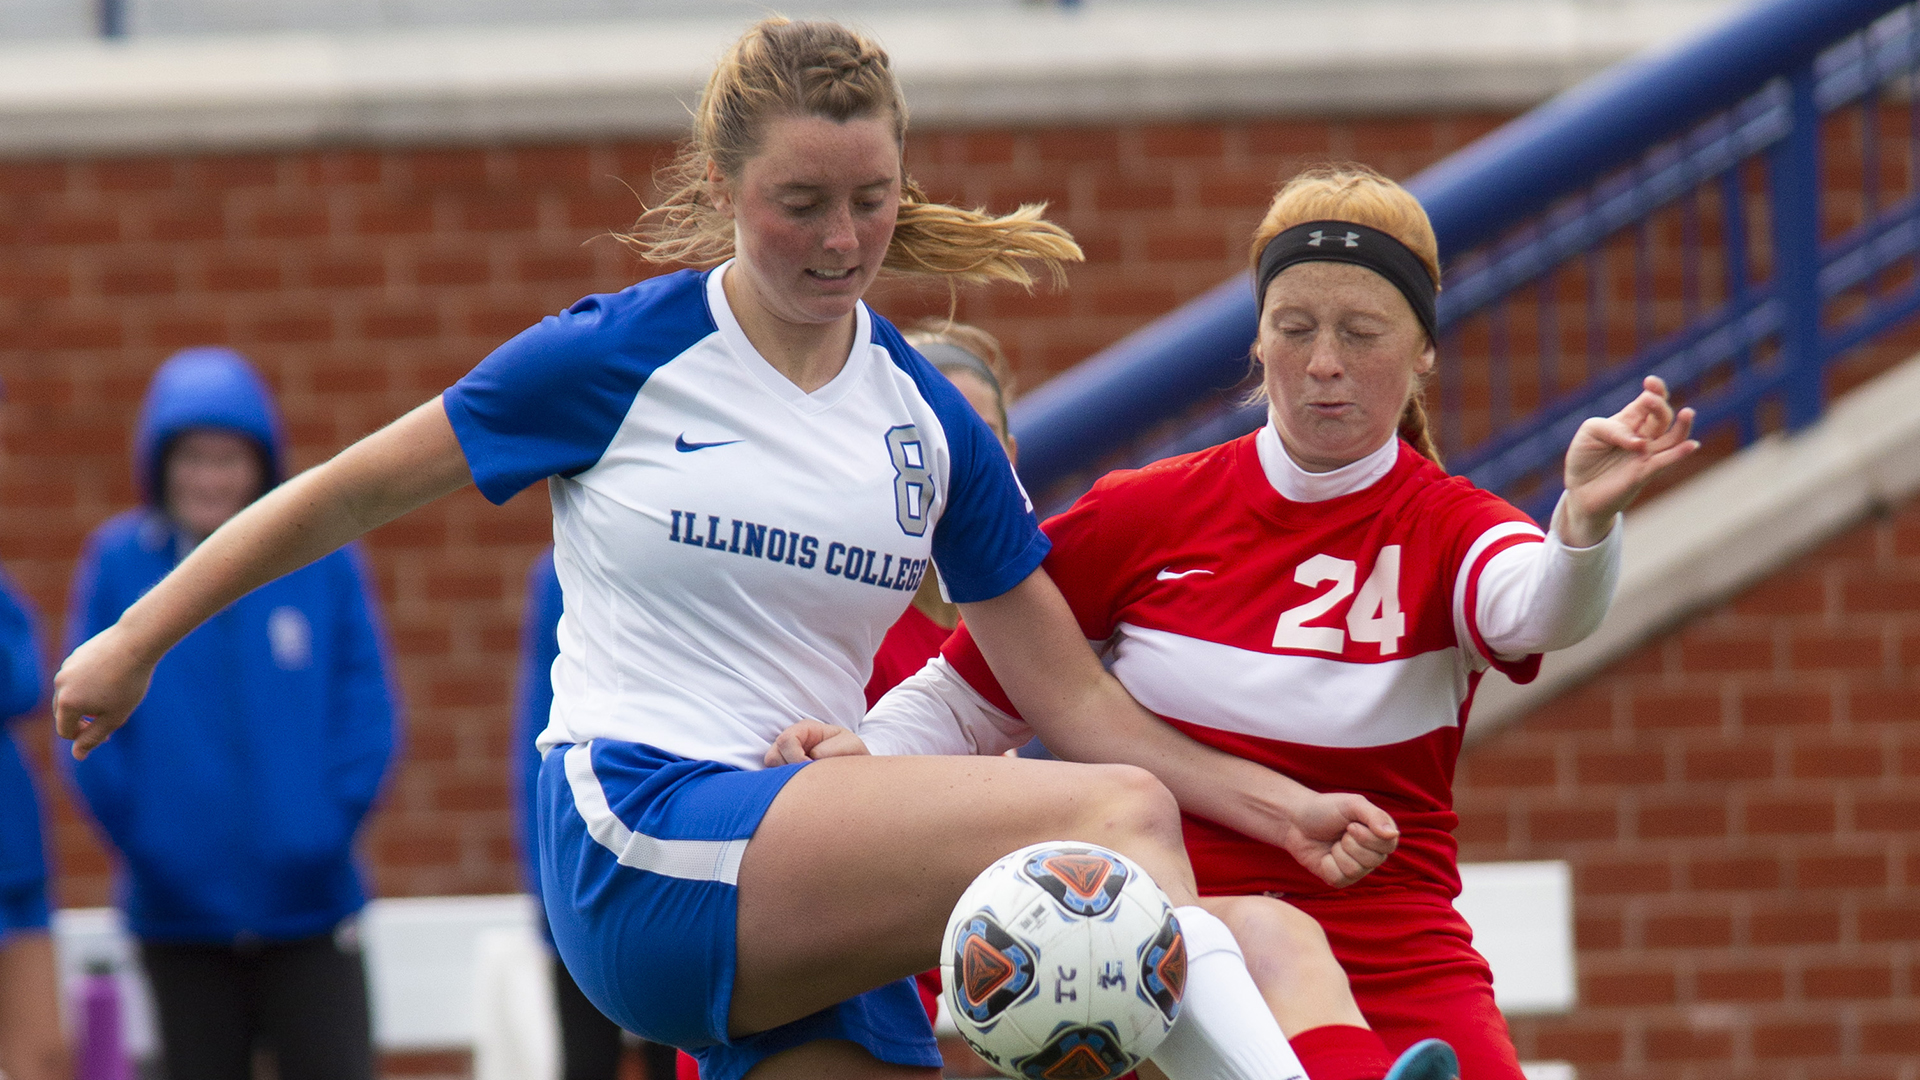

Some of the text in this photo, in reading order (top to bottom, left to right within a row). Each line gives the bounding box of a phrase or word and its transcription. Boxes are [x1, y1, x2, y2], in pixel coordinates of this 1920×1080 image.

[884, 424, 935, 538] 8
[669, 509, 928, 592] ILLINOIS COLLEGE
[1272, 544, 1406, 656] 24
